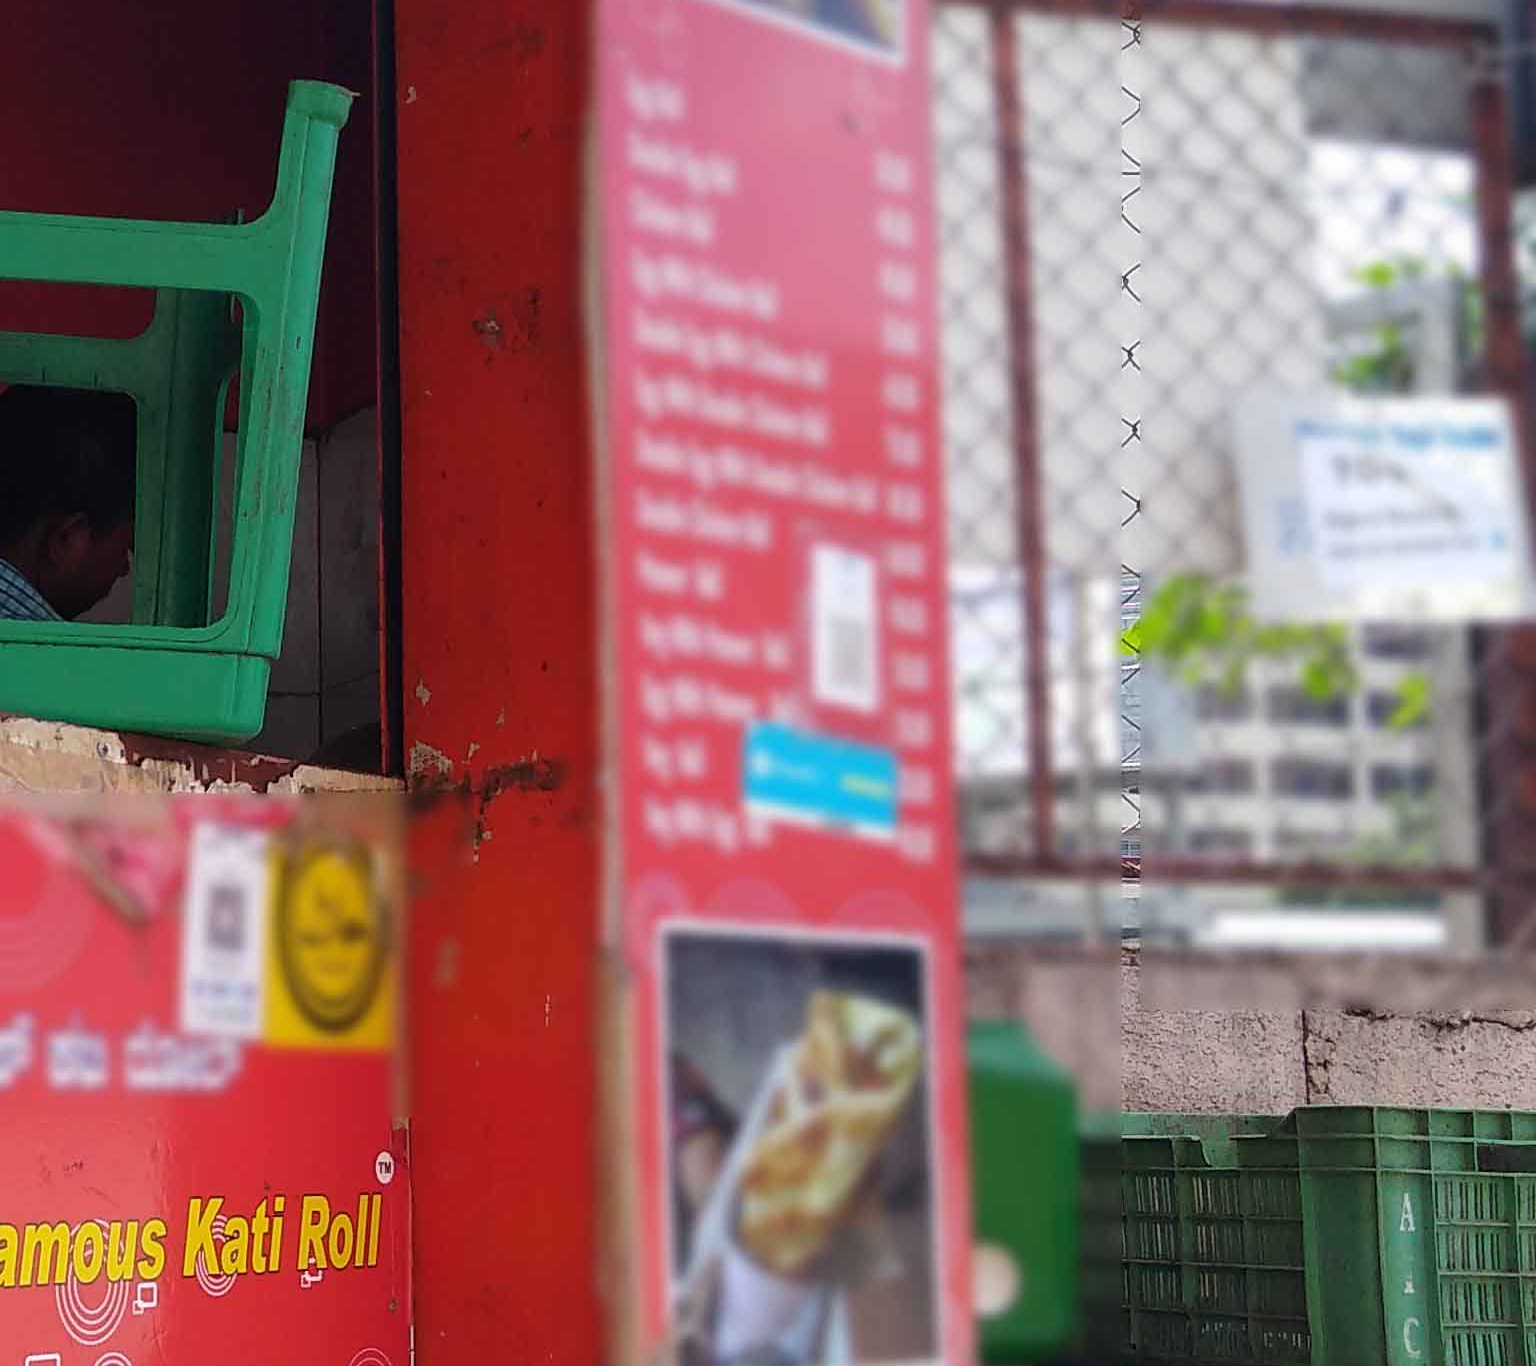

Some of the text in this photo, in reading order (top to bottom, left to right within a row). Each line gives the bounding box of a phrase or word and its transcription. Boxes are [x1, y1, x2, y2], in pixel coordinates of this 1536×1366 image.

[376, 1160, 393, 1176] TM
[183, 1196, 286, 1278] Kati
[297, 1193, 382, 1270] Roll
